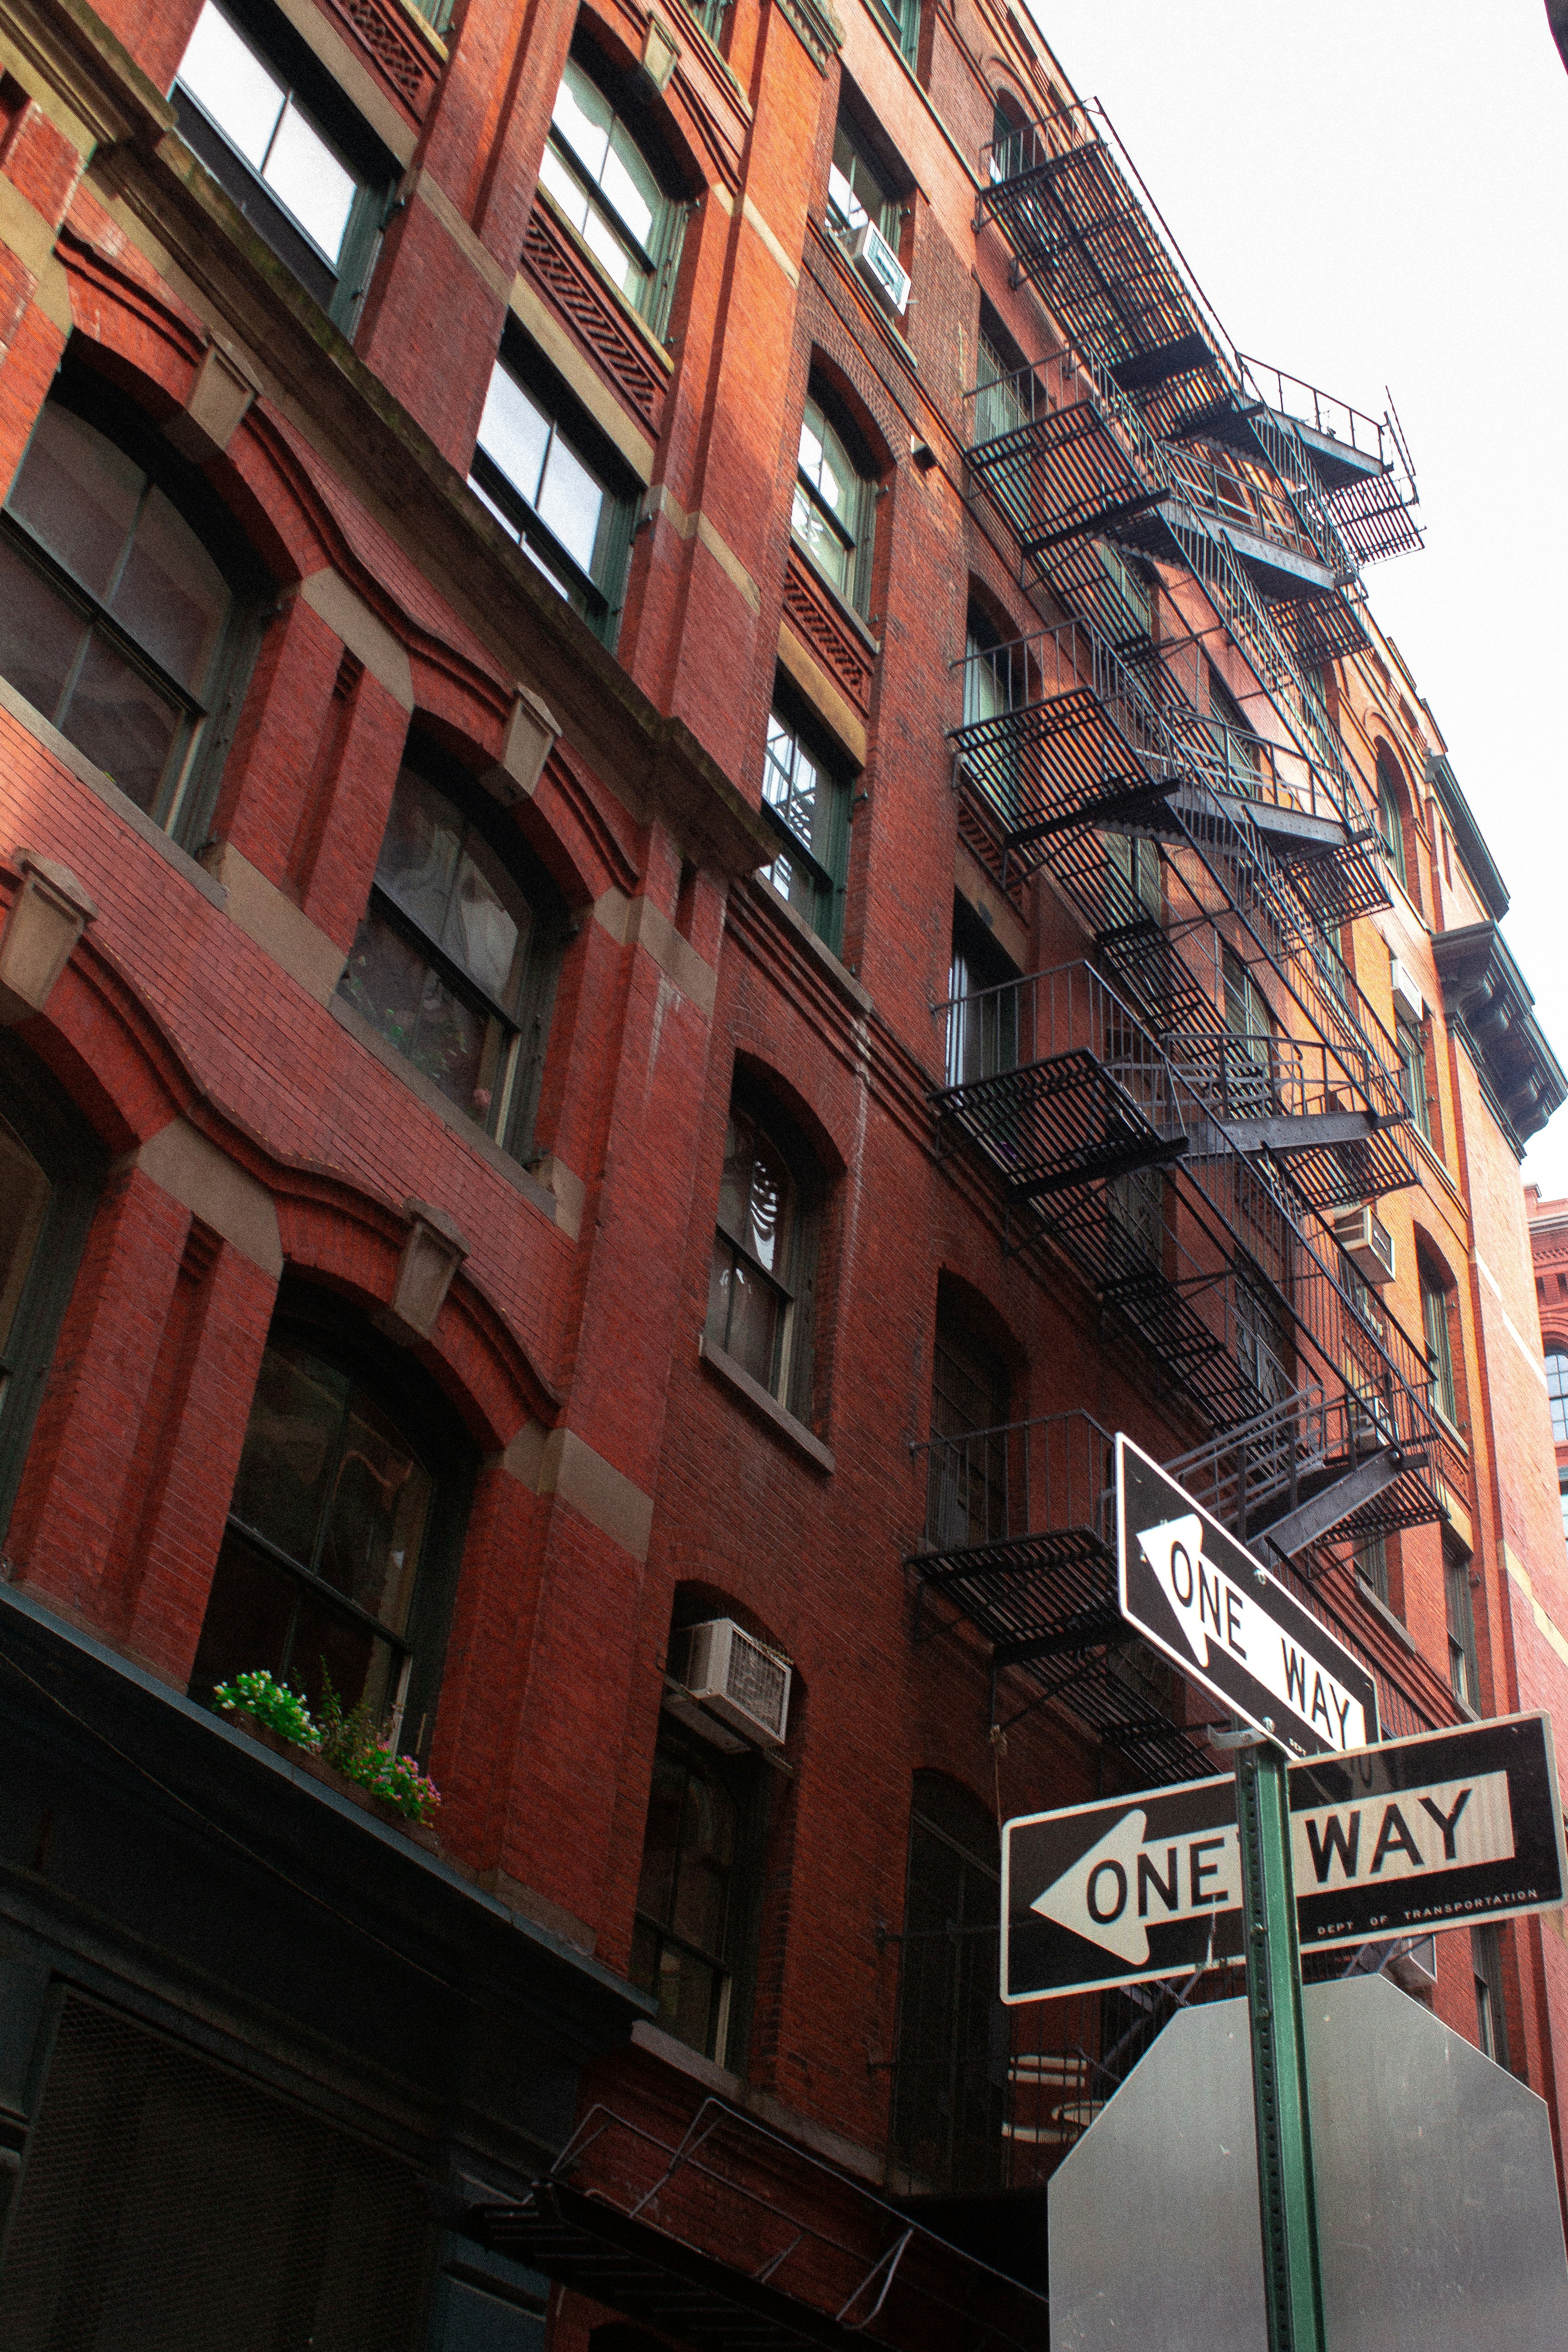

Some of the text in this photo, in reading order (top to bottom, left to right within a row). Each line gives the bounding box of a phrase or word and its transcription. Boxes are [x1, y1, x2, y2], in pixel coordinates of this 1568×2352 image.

[1171, 1540, 1351, 1750] ONE WAY
[1087, 1788, 1472, 1924] ONE WAY
[1317, 1889, 1539, 1935] DEPT OF TRANSPORTATION
